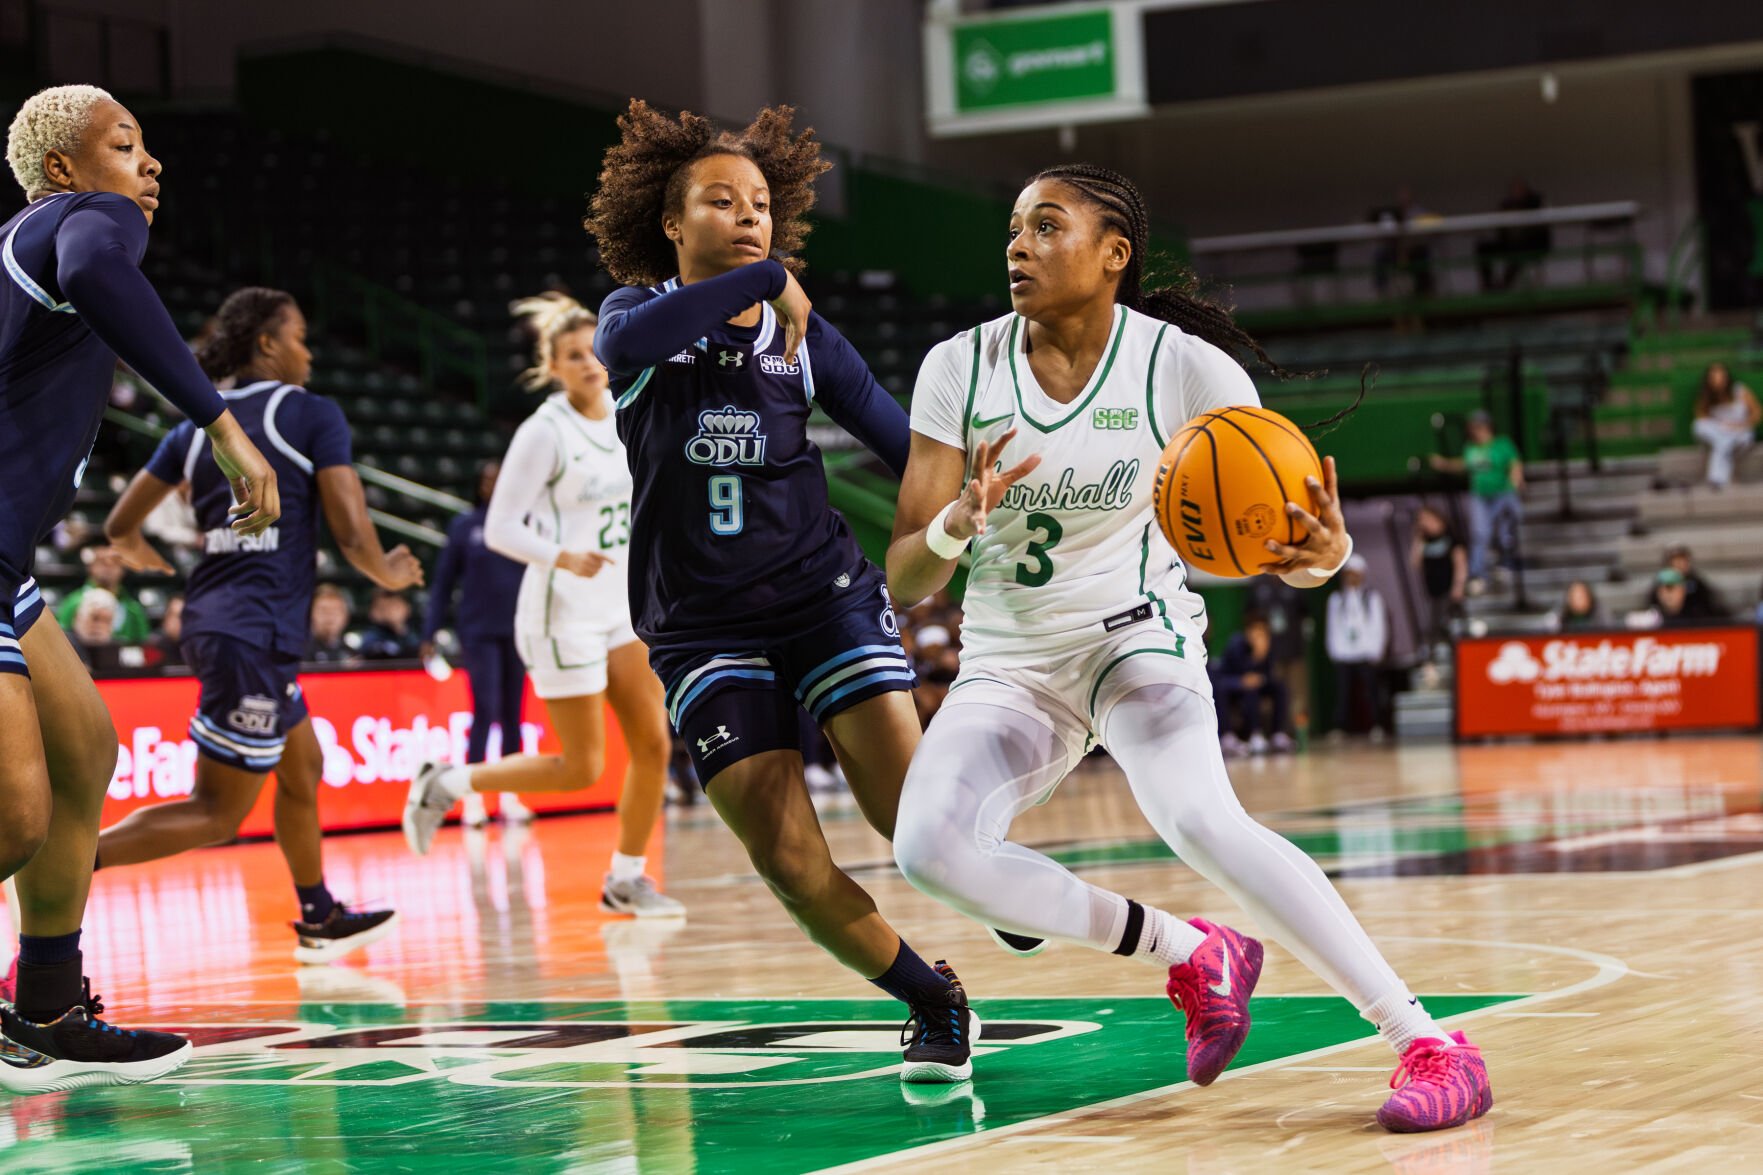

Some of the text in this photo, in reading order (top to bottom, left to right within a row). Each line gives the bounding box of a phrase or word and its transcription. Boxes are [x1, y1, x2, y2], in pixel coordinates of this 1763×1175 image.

[760, 354, 800, 374] SBC
[1093, 407, 1138, 430] SBC
[685, 434, 767, 466] ODU
[708, 475, 743, 535] 9
[994, 458, 1140, 512] arshall
[599, 502, 632, 550] 23
[1016, 512, 1063, 588] 3
